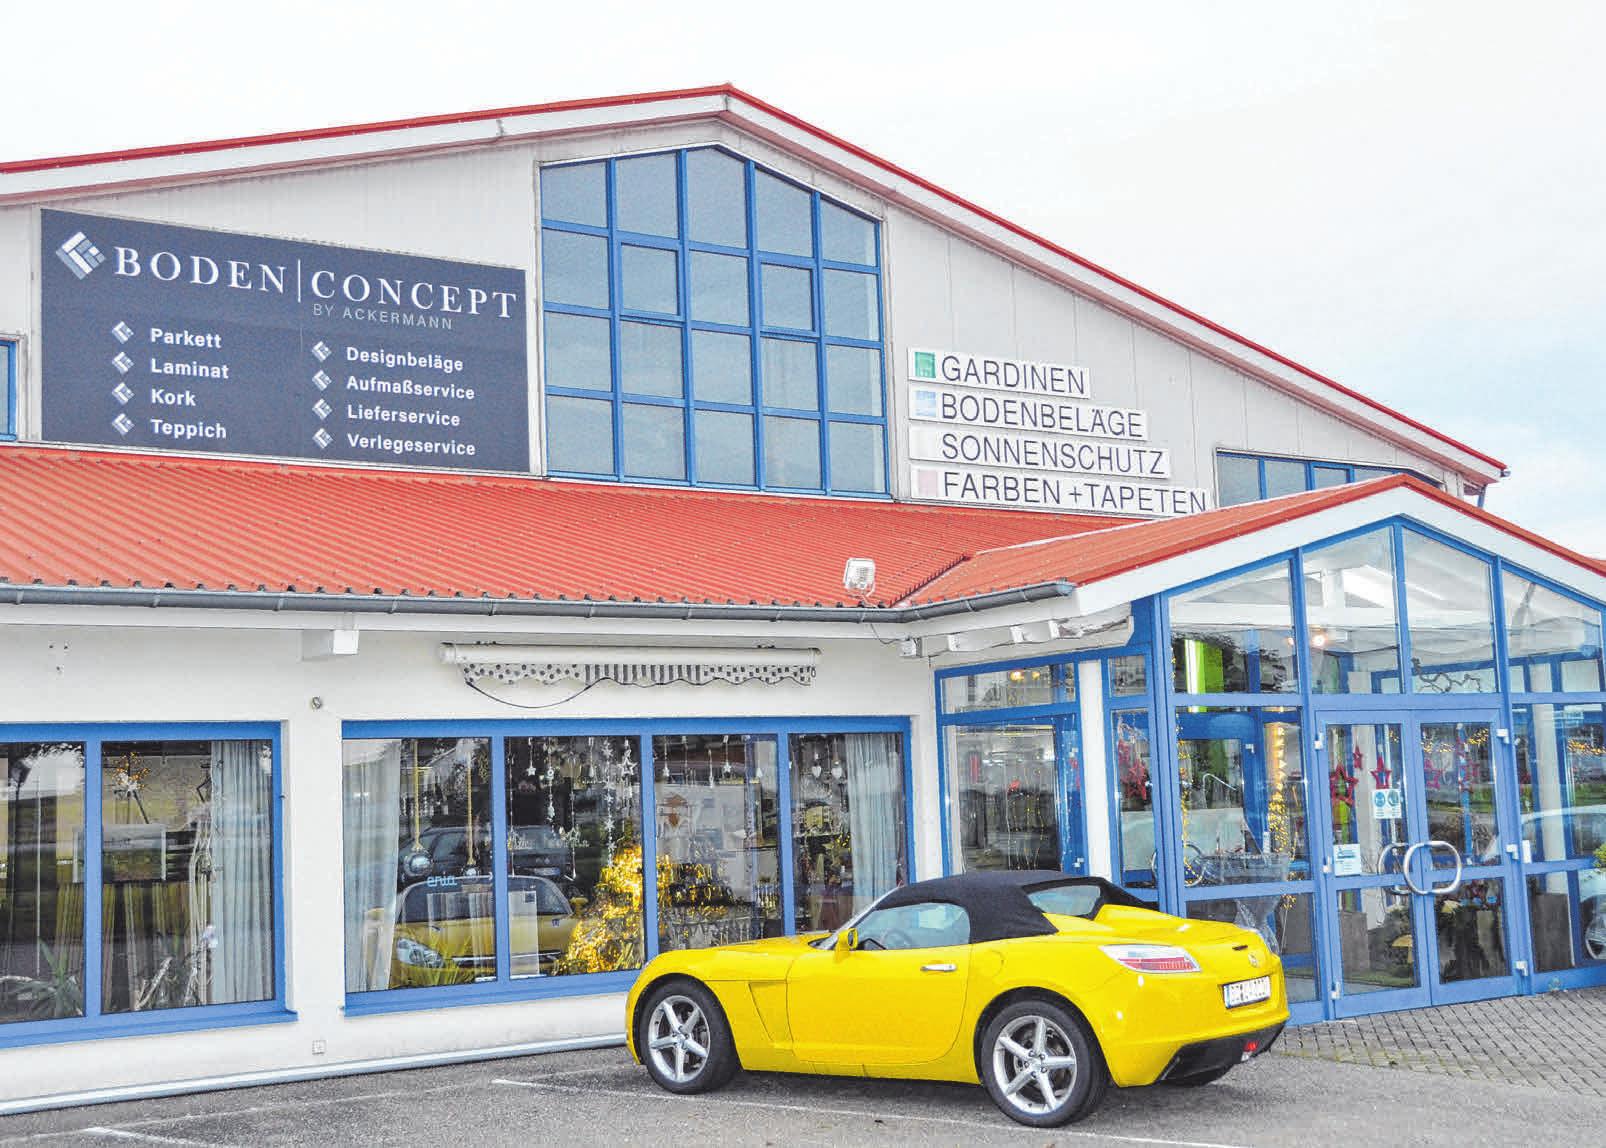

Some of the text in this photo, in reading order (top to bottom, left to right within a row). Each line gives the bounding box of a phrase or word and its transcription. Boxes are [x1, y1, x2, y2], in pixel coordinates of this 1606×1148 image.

[113, 246, 518, 319] BODEN CONCEPT
[312, 303, 454, 331] BY ACKERMANN
[150, 327, 222, 349] Parkett
[150, 357, 229, 379] Laminat
[346, 346, 464, 373] Designbeläge
[346, 375, 475, 400] Aufmaßservice
[941, 355, 1085, 395] GARDINEN
[151, 388, 197, 407] Kork
[347, 404, 461, 427] Lieferservice
[941, 392, 1143, 438] BODENBELÄGE
[150, 418, 227, 440] Teppich
[346, 433, 476, 456] Verlegeservice
[941, 433, 1165, 475] SONNENSCHUTZ
[944, 471, 1062, 505] FARBEN
